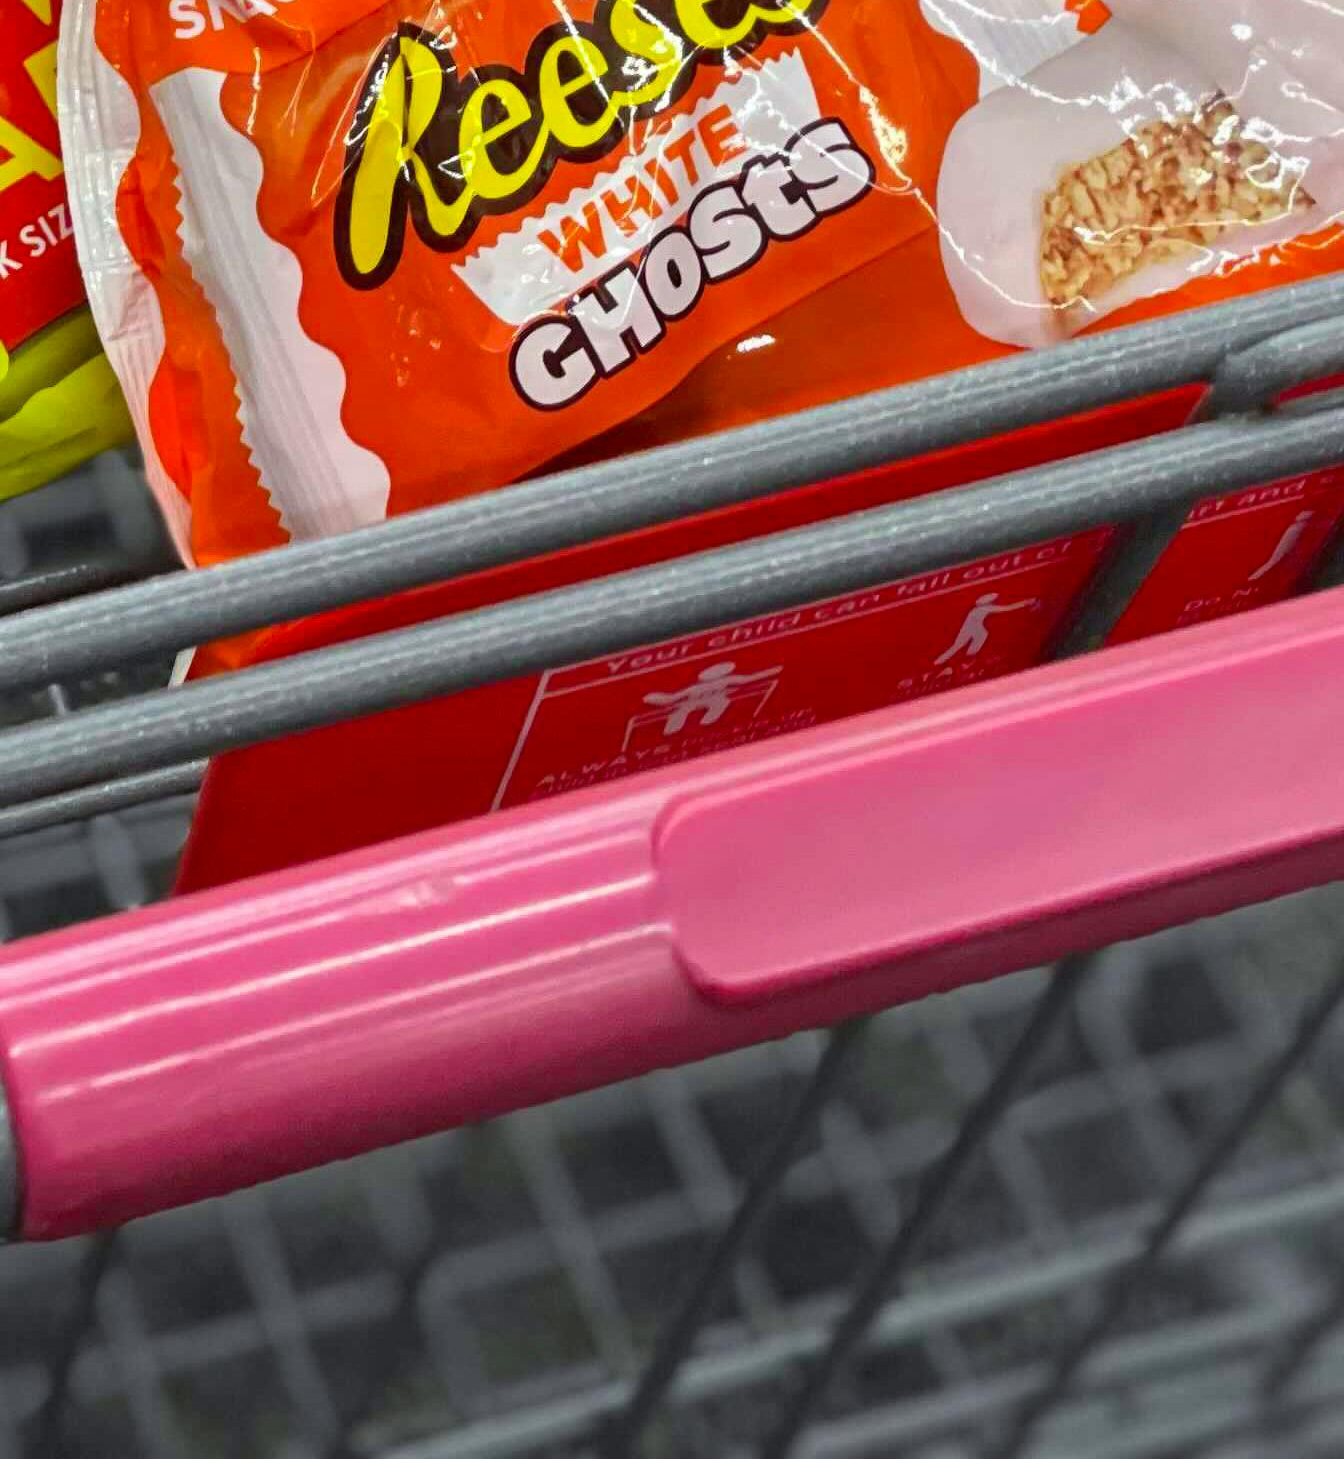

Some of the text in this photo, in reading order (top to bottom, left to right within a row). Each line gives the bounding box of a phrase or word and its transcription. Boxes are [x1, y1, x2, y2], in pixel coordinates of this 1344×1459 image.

[19, 202, 74, 258] SIZ
[537, 103, 748, 275] WHITE
[1237, 479, 1306, 507] and
[606, 641, 694, 674] Your
[707, 611, 801, 648] child
[813, 593, 881, 621] can
[962, 553, 1024, 579] out
